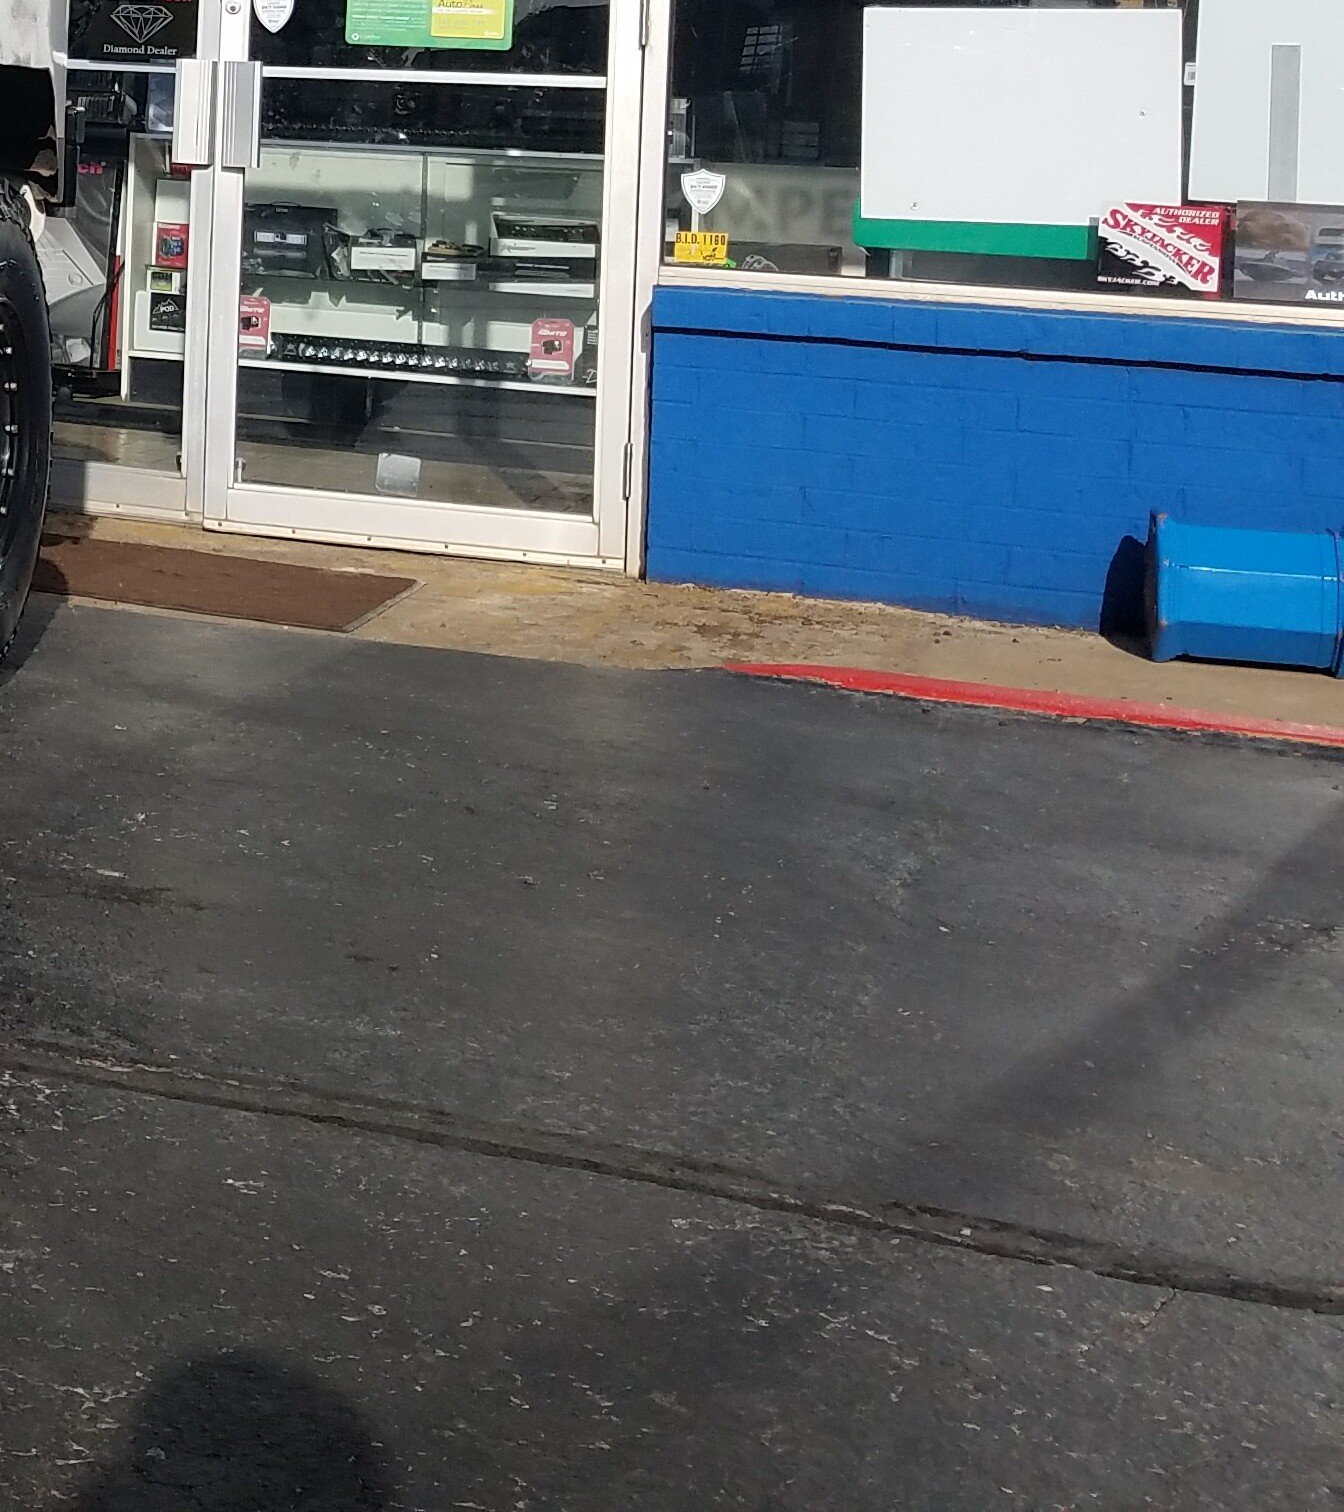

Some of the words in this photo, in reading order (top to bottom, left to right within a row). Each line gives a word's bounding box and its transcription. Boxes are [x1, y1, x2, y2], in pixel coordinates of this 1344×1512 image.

[103, 44, 146, 55] Diamond
[146, 45, 178, 56] Dealer
[1152, 207, 1220, 218] AUTHORIZED
[1178, 215, 1220, 226] DEALER
[1102, 208, 1217, 285] SKYJACKER
